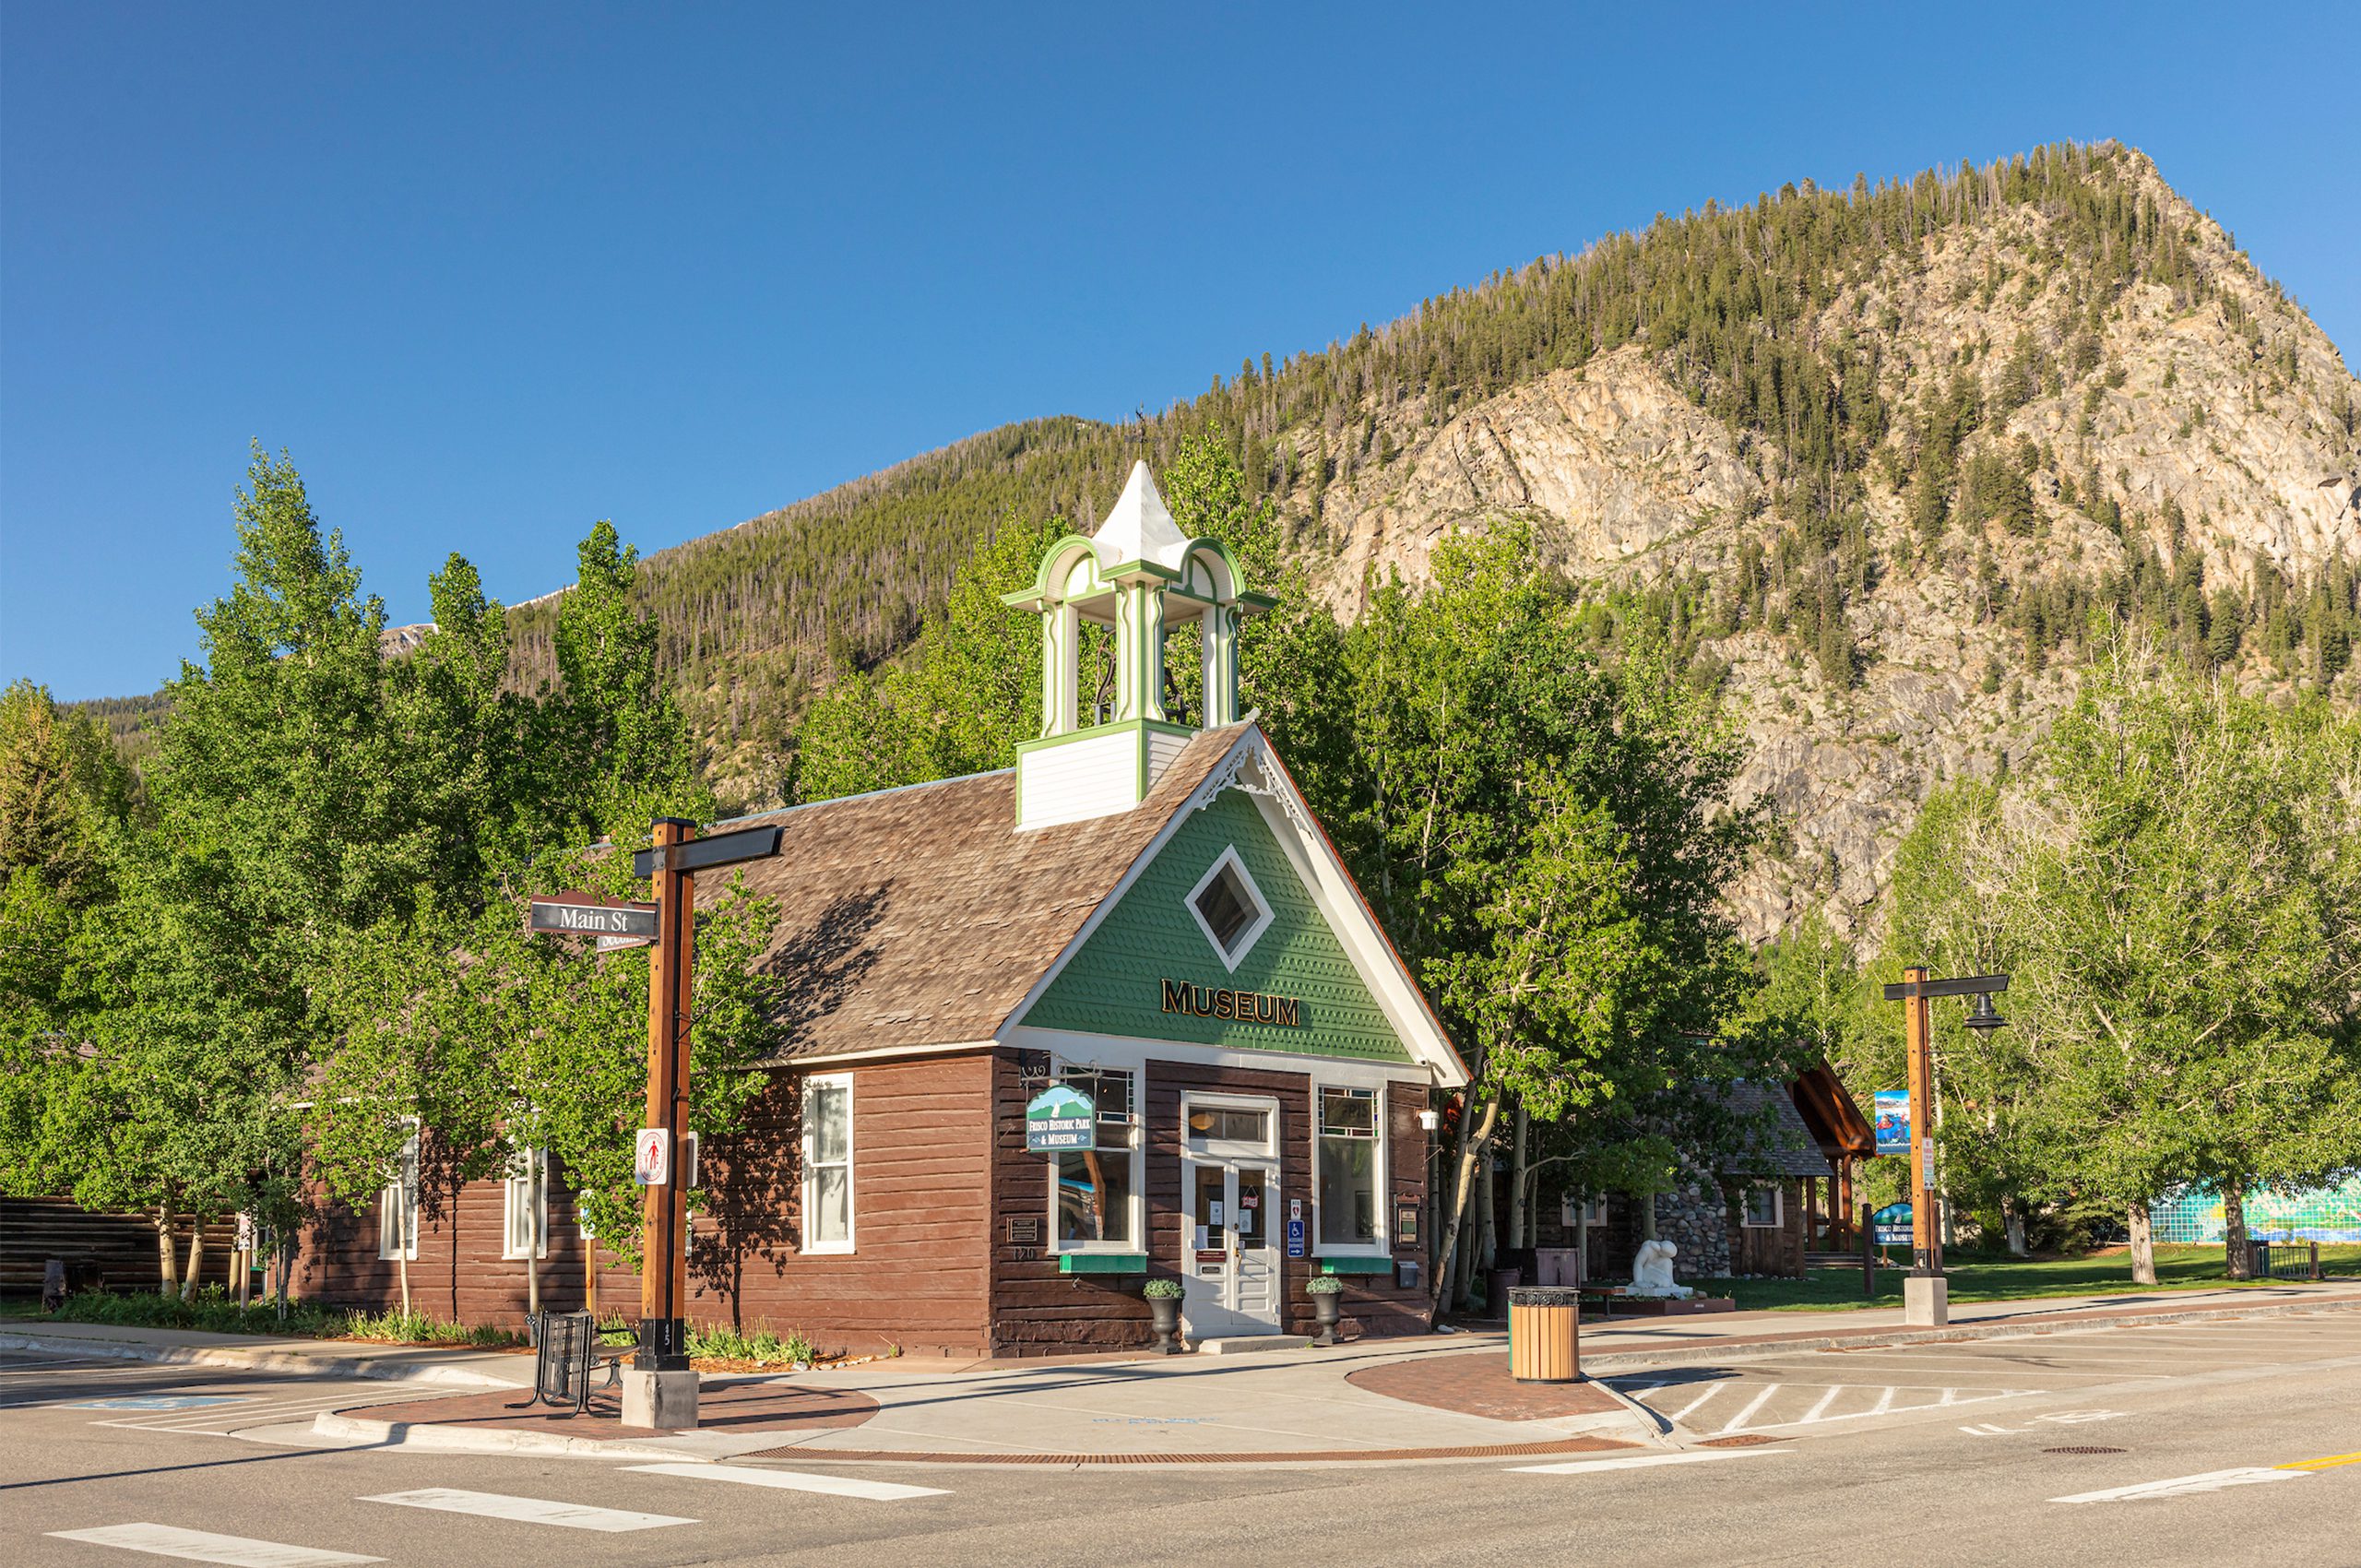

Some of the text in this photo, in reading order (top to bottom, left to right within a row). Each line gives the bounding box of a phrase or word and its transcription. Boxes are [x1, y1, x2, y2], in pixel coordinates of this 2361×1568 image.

[560, 908, 628, 932] Main St
[1161, 979, 1300, 1027] MUSEUM
[1029, 1118, 1090, 1132] FRISCO HISTORIC PARK
[1040, 1134, 1078, 1146] & MUSEUM
